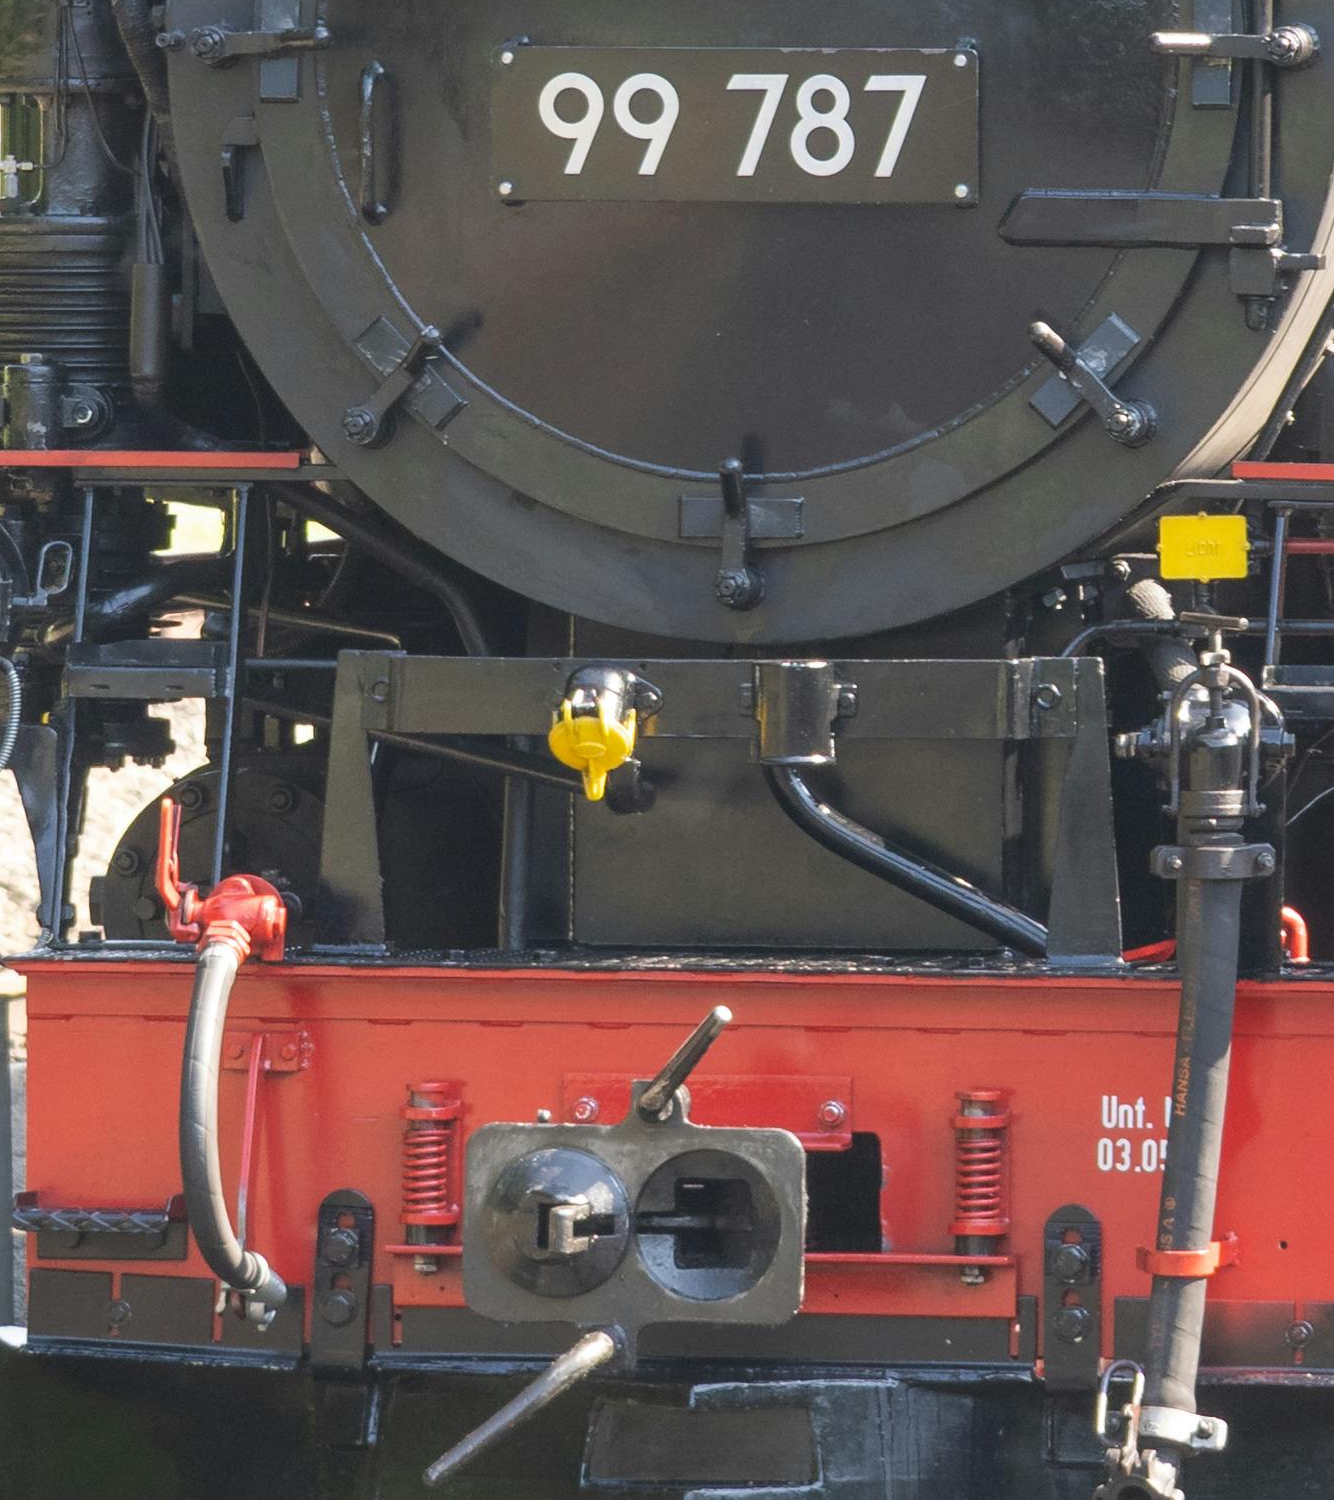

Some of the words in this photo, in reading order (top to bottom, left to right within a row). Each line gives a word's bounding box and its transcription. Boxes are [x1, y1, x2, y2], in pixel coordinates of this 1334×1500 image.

[538, 72, 680, 176] 99
[726, 73, 927, 178] 787
[1101, 1095, 1154, 1129] Unt.
